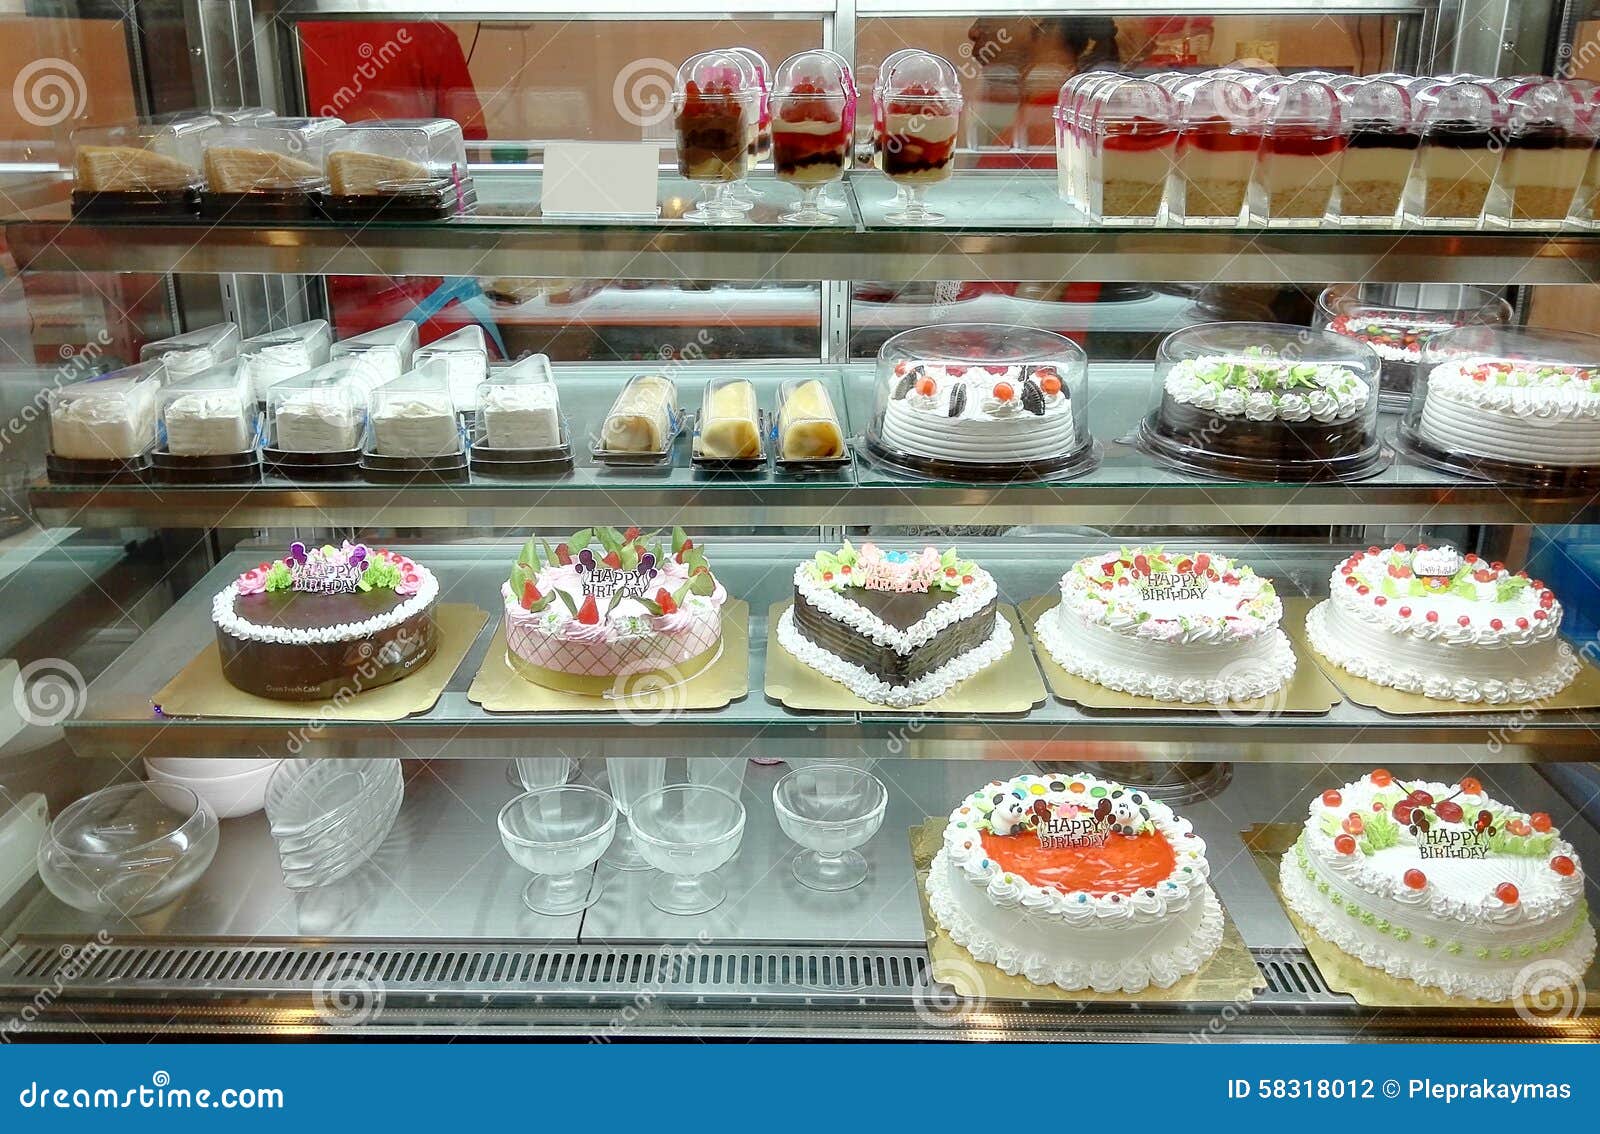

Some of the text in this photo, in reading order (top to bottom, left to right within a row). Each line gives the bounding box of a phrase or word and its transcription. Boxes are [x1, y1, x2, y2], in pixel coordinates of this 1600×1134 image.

[589, 568, 641, 586] HAPPY
[1147, 572, 1200, 588] HAPPY
[582, 583, 650, 598] BIRTDAY
[1140, 587, 1208, 601] BIRTHDAY
[1047, 818, 1102, 834] HAPPY
[1040, 834, 1107, 849] BIRTHDAY
[1426, 829, 1481, 846] HAPPY
[1419, 845, 1489, 860] BIRTHDAY
